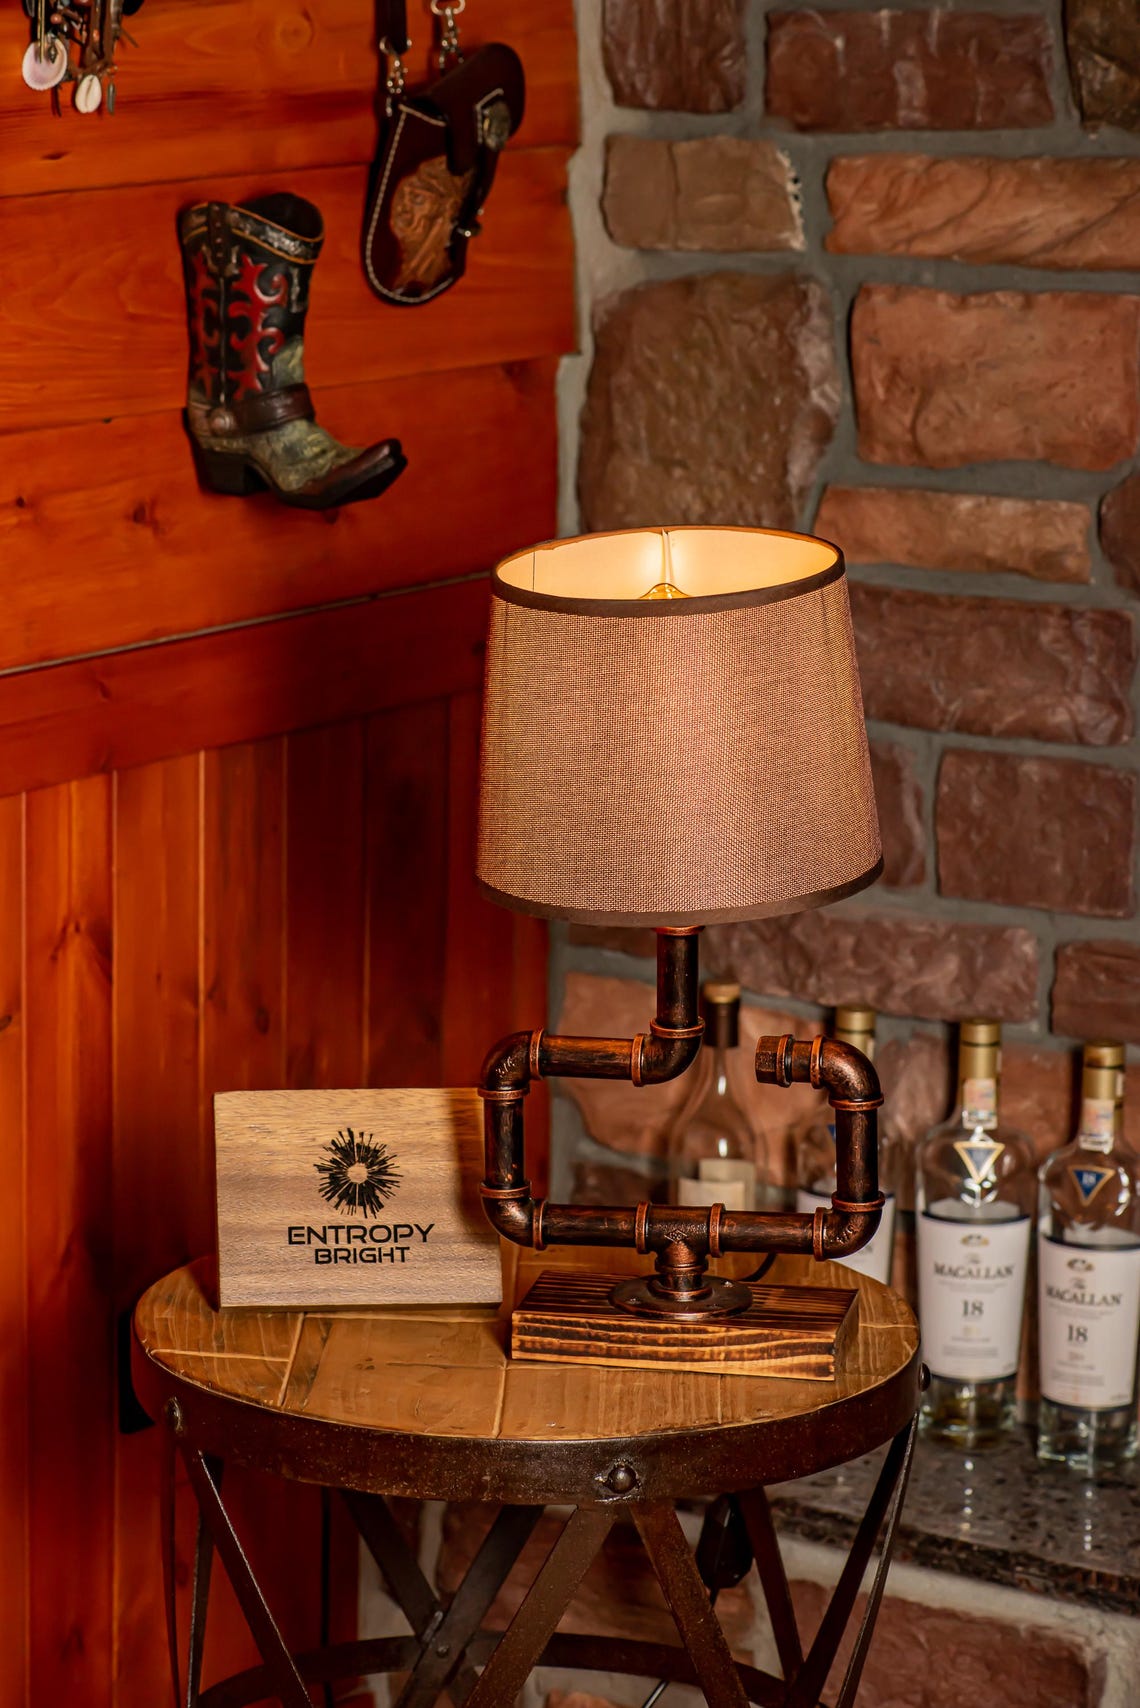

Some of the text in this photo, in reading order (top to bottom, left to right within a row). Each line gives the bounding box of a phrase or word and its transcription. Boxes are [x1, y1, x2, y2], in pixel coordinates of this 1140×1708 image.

[287, 1223, 435, 1245] ENTROPY
[314, 1246, 410, 1265] BRIGHT
[934, 1260, 1016, 1280] MACALLAN
[1046, 1283, 1123, 1307] MACALLAN
[962, 1299, 984, 1318] 18
[1067, 1324, 1088, 1343] 18
